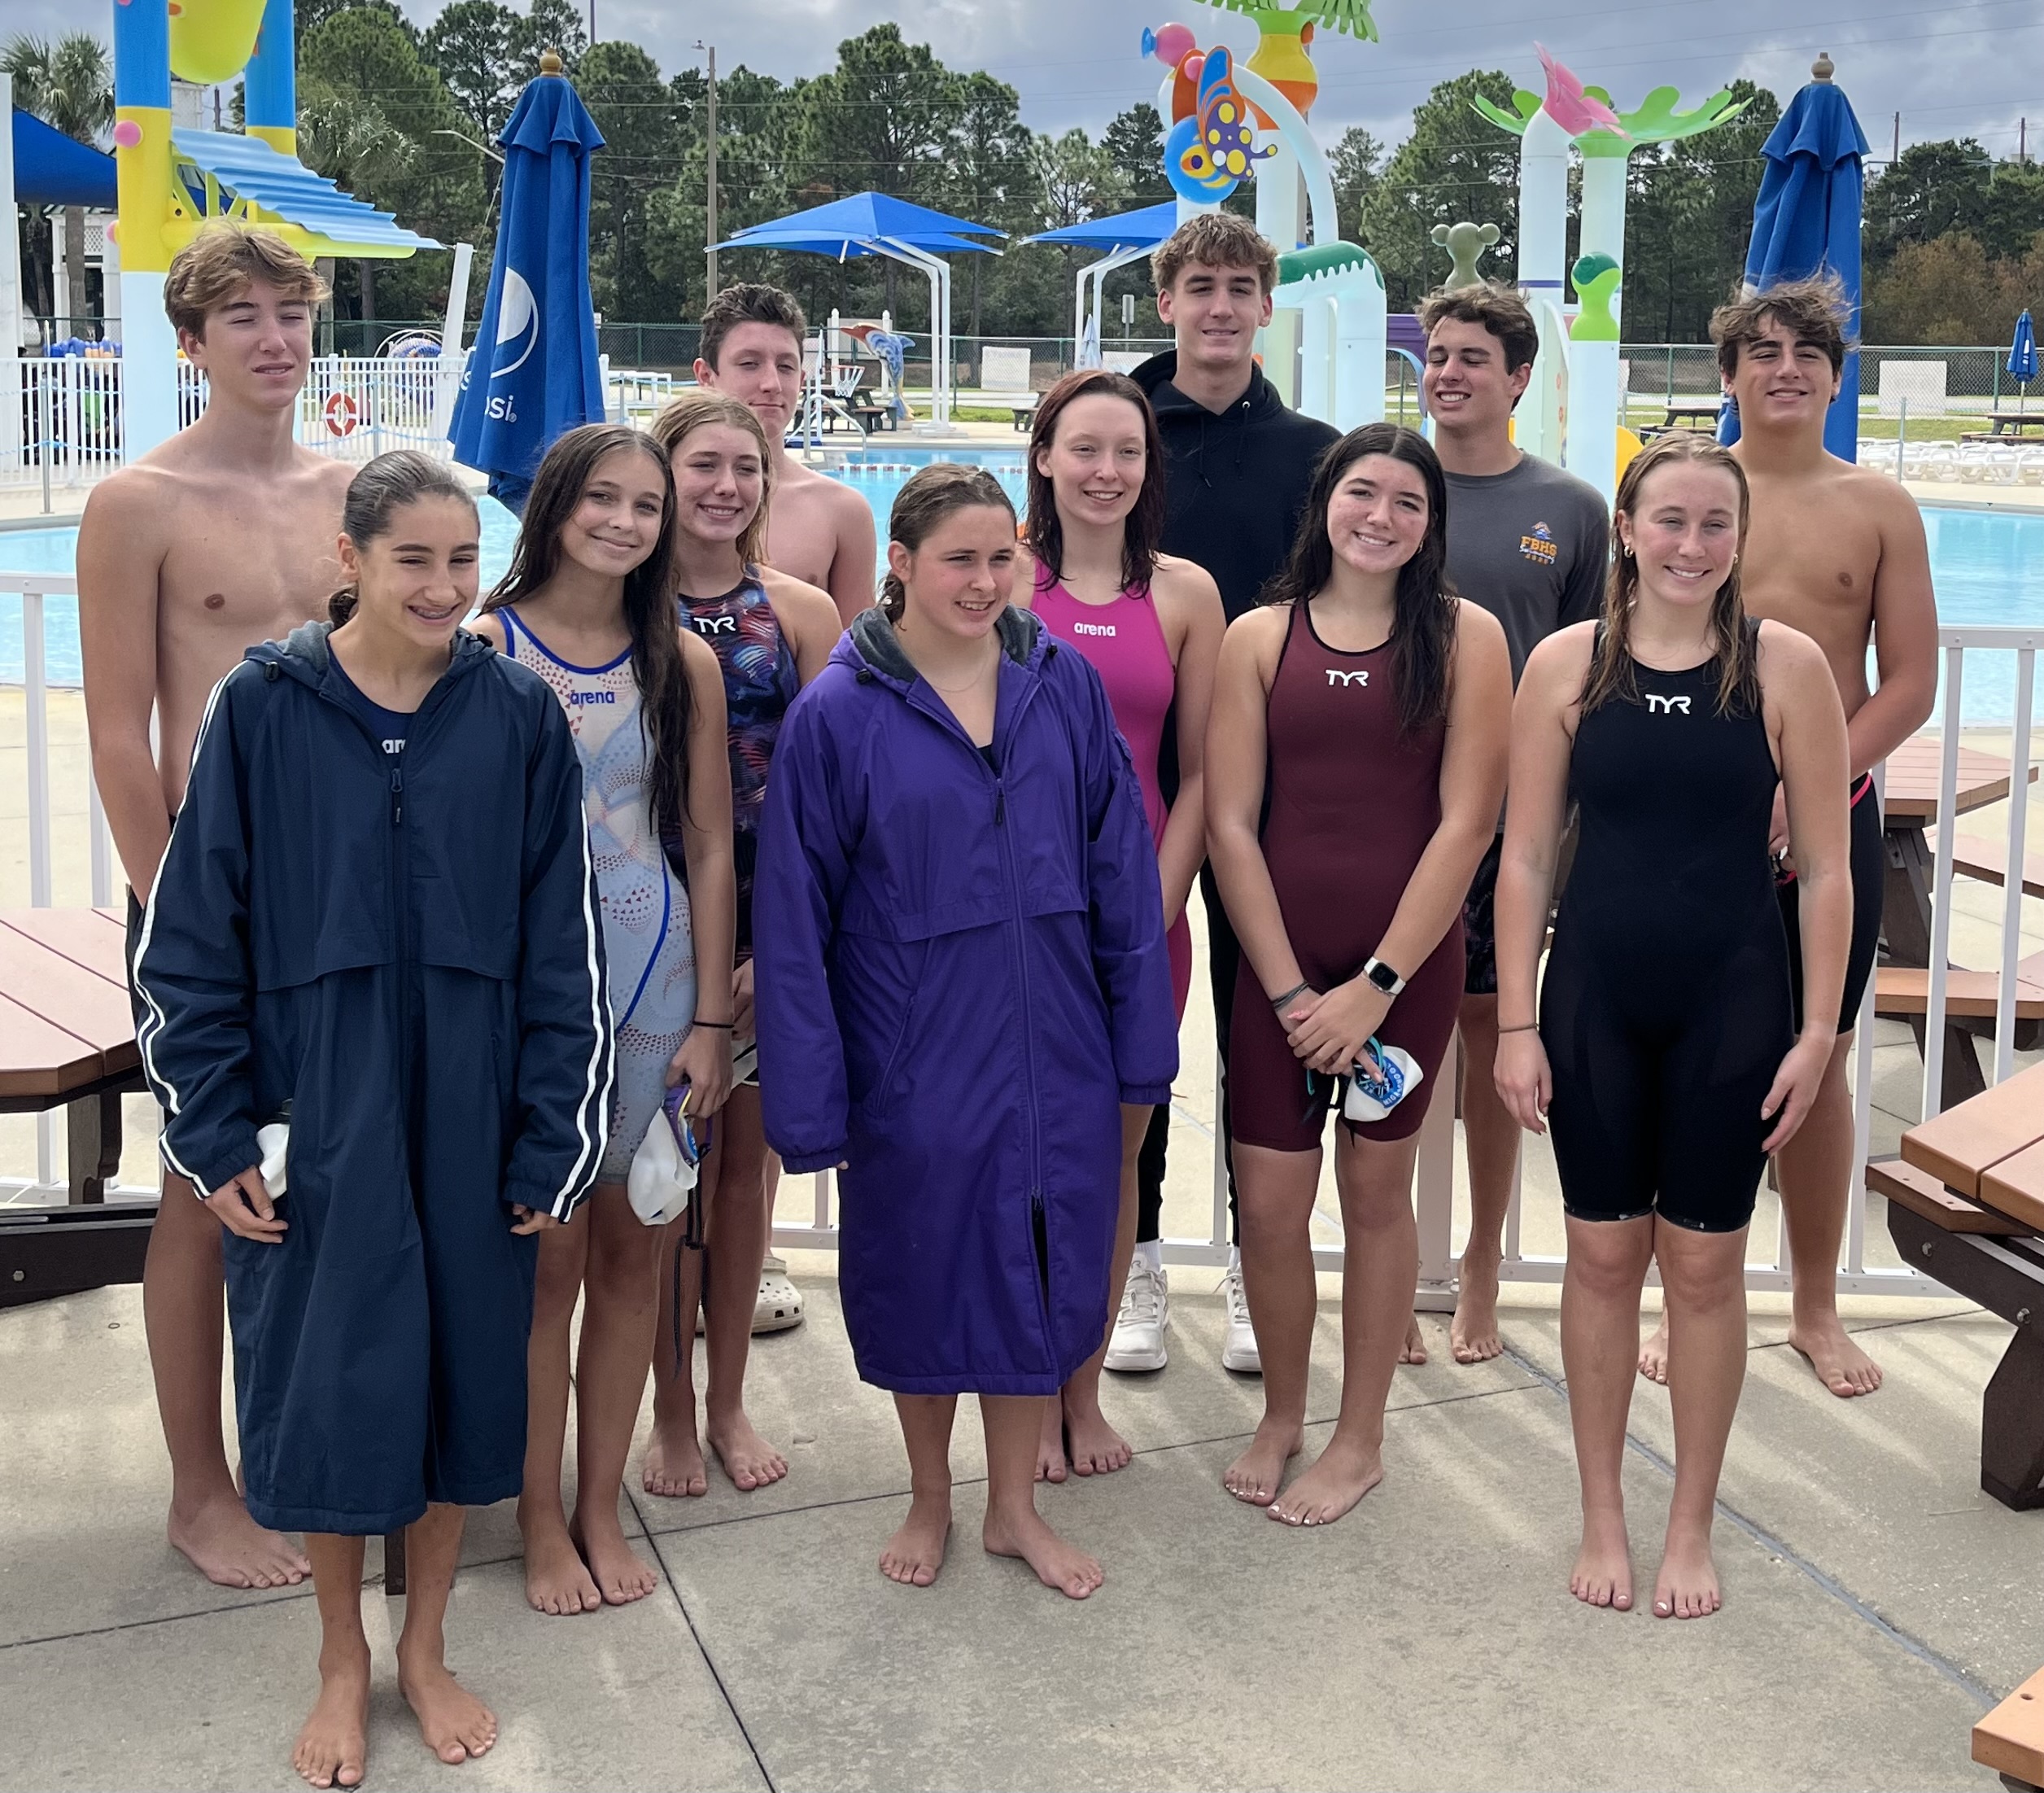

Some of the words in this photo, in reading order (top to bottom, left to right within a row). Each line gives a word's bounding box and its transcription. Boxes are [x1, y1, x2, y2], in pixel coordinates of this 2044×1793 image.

[1521, 536, 1557, 558] FBHS
[693, 616, 736, 634] TYR
[1074, 623, 1116, 636] arena
[1325, 669, 1369, 687] TYR
[570, 691, 615, 705] arena
[1644, 693, 1692, 715] TYR
[381, 738, 406, 754] ar
